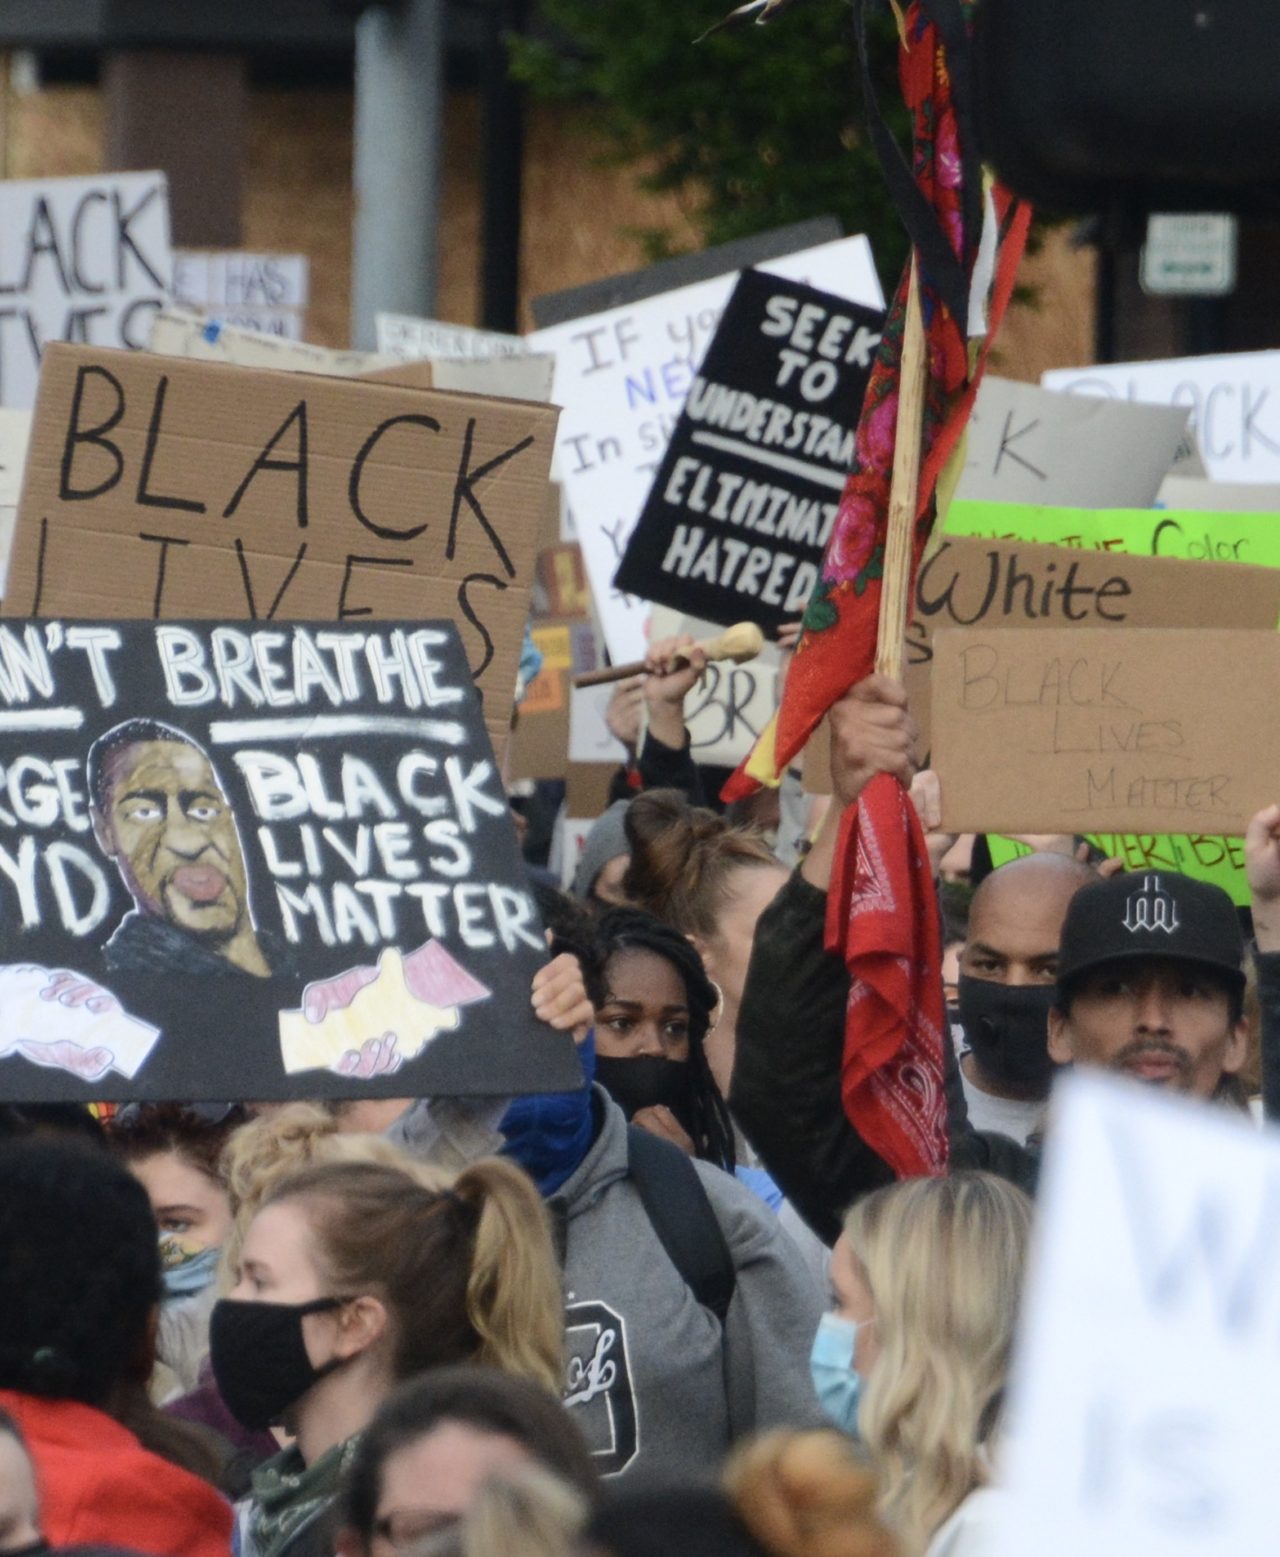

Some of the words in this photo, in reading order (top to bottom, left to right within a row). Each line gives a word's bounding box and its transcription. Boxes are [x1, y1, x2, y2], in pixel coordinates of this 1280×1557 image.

[574, 316, 642, 378] IF
[666, 308, 722, 366] yo
[760, 295, 884, 368] SEEK
[776, 350, 840, 404] TO
[562, 432, 622, 476] In
[686, 376, 857, 466] UNDERSTAN
[58, 365, 536, 580] BLACK
[663, 456, 840, 548] ELIMINAT
[30, 515, 510, 682] LIVES
[661, 523, 820, 614] HATRED
[914, 540, 1134, 628] White
[154, 626, 466, 708] BREATHE
[956, 642, 1132, 712] BLACK
[1050, 708, 1186, 756] LIVES
[233, 750, 508, 830] BLACK
[1084, 766, 1234, 810] MATTER
[258, 820, 474, 880] LIVES
[274, 882, 550, 952] MATTER
